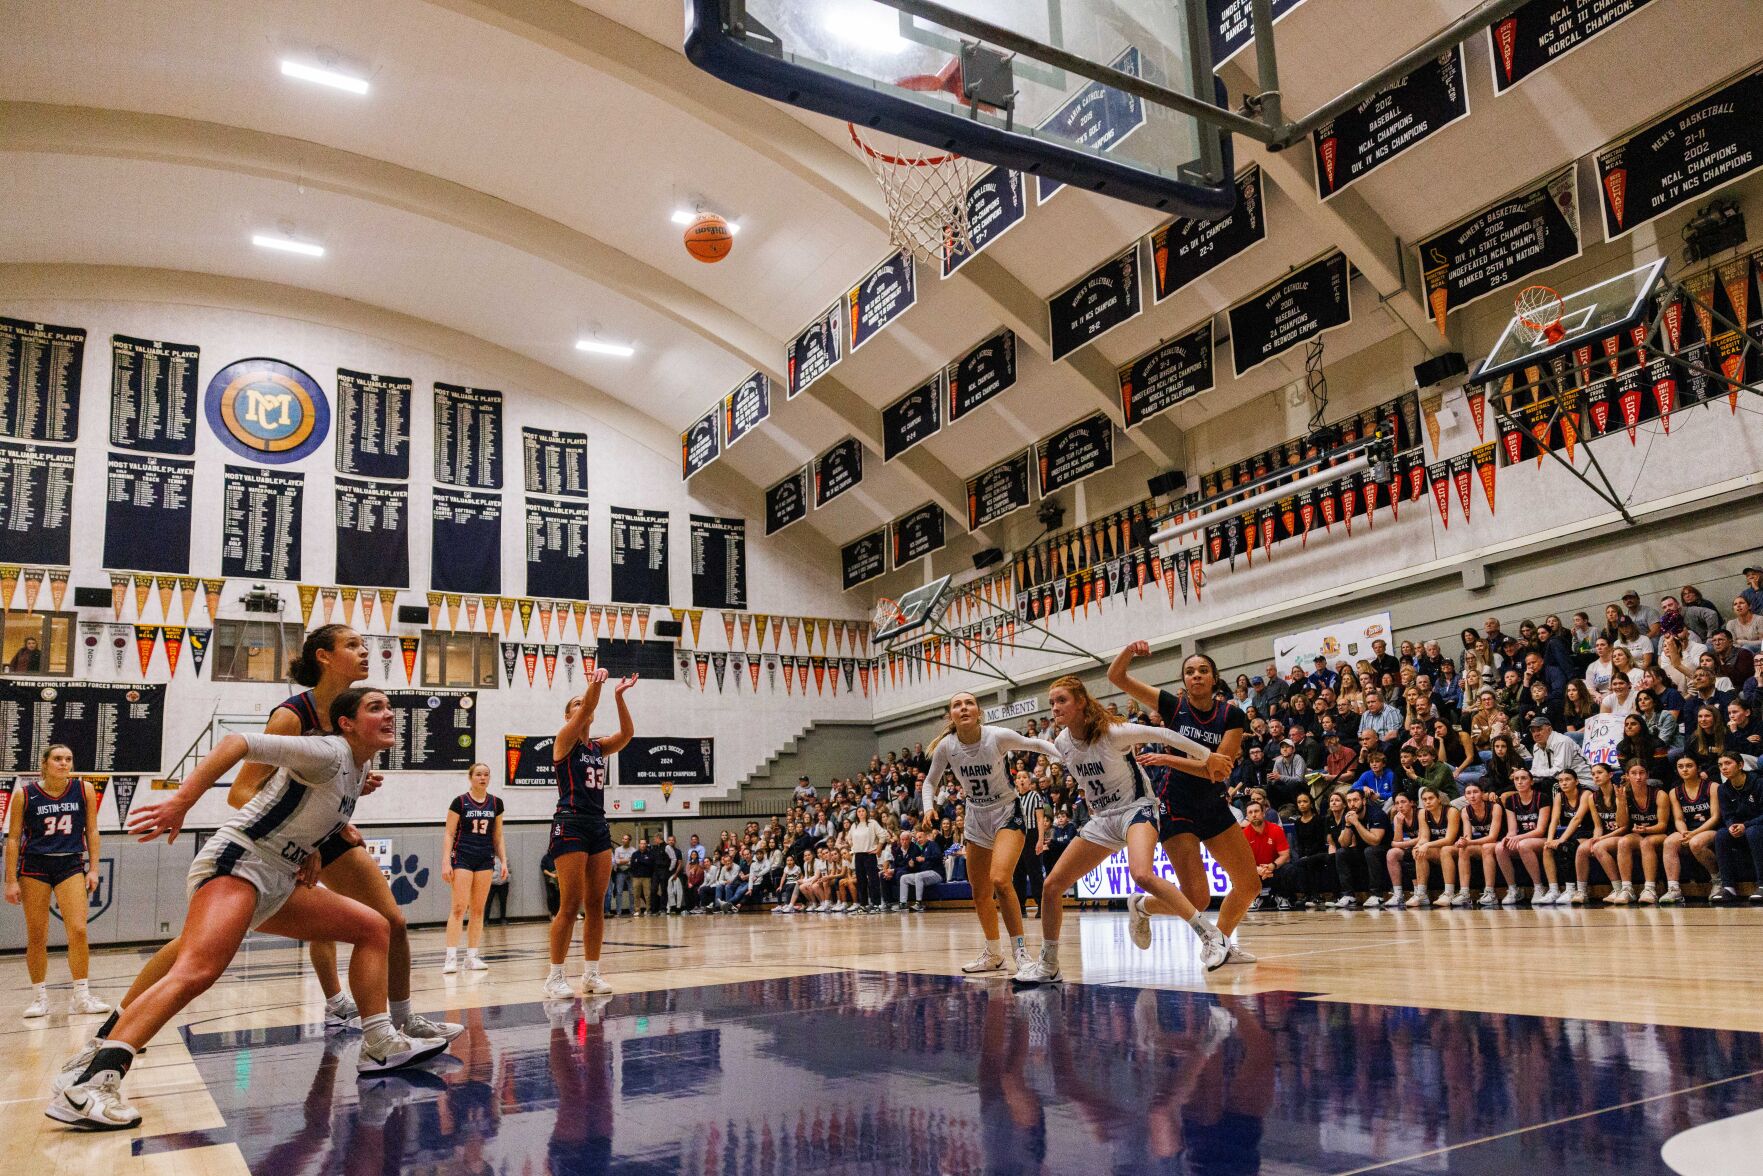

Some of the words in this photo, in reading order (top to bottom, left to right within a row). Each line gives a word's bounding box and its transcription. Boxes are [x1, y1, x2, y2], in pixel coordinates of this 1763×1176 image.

[1550, 7, 1572, 25] MCAL
[1225, 18, 1247, 42] RANKED
[1538, 30, 1554, 47] NCS
[1559, 20, 1574, 36] DIV.
[1578, 9, 1589, 23] III
[1549, 31, 1582, 56] NORCAL
[1585, 1, 1635, 34] CHAMPIONS
[1375, 96, 1393, 113] 2012
[1369, 106, 1402, 132] BASEBALL
[1651, 129, 1676, 152] MEN'S
[1679, 103, 1735, 131] BASKETBALL
[1358, 139, 1375, 154] MCAL
[1377, 114, 1413, 141] CHAMPIONS
[1366, 154, 1372, 165] IV
[1375, 145, 1389, 160] NCS
[1391, 121, 1428, 149] CHAMPIONS
[1684, 129, 1706, 147] 21-11
[1683, 141, 1710, 162] 2002
[1661, 170, 1684, 188] MCAL
[1687, 143, 1738, 175] CHAMPIONS
[1651, 194, 1666, 207] DIV.
[1669, 186, 1679, 198] IV
[1682, 176, 1700, 192] NCS
[1702, 151, 1753, 183] CHAMPIONS
[1179, 247, 1190, 257] NCS
[1206, 216, 1233, 239] CHAMPIONS
[1458, 218, 1485, 245] WOMEN'S
[1484, 220, 1505, 237] 2002
[1199, 242, 1214, 257] 22-3
[1469, 247, 1476, 259] IV
[1479, 238, 1498, 253] STATE
[1448, 255, 1488, 280] UNDEFEATED
[1490, 245, 1508, 260] MCAL
[1458, 270, 1484, 289] RANKED
[1485, 260, 1504, 276] 25TH
[1507, 255, 1514, 267] IN
[1516, 244, 1540, 262] NATION
[1490, 272, 1508, 287] 29-5
[1265, 291, 1282, 310] MARIN
[1283, 281, 1309, 296] CATHOLIC
[1275, 306, 1301, 324] BASEBALL
[1279, 313, 1308, 333] CHAMPIONS
[1262, 343, 1272, 354] NCS
[1273, 331, 1298, 347] REDWOOD
[1299, 319, 1318, 334] EMPIRE
[113, 341, 133, 350] MOST
[135, 345, 170, 356] VALUABLE
[172, 350, 198, 358] PLAYER
[1721, 346, 1741, 357] MCAL
[1178, 361, 1202, 379] CHAMPIONS
[1652, 371, 1670, 381] MCAL
[1165, 380, 1184, 395] FINALIST
[1171, 384, 1195, 401] CALIFORNIA
[1619, 383, 1638, 392] MCAL
[8, 449, 45, 460] VALUABLE
[46, 453, 74, 462] PLAYER
[1478, 456, 1492, 464] MCAL
[129, 463, 167, 473] VALUABLE
[167, 466, 194, 475] PLAYER
[1432, 471, 1446, 479] MCAL
[1454, 463, 1469, 471] MCAL
[244, 474, 278, 484] VALUABLE
[279, 478, 304, 486] PLAYER
[335, 484, 353, 492] MOST
[353, 486, 385, 495] VALUABLE
[385, 490, 408, 498] PLAYER
[450, 496, 480, 505] VALUABLE
[481, 499, 502, 507] PLAYER
[986, 708, 1000, 720] MC
[1001, 700, 1036, 718] PARENTS
[533, 738, 554, 751] WOMEN'S
[648, 745, 667, 755] WOMEN'S
[668, 745, 684, 755] SOCCER
[585, 766, 605, 790] 33
[959, 764, 992, 778] MARIN
[1076, 761, 1105, 777] MARIN
[117, 786, 132, 797] NCS
[969, 779, 989, 797] 21
[36, 802, 79, 816] JUSTIN-SIENA
[44, 814, 73, 836] 34
[471, 819, 489, 834] 13
